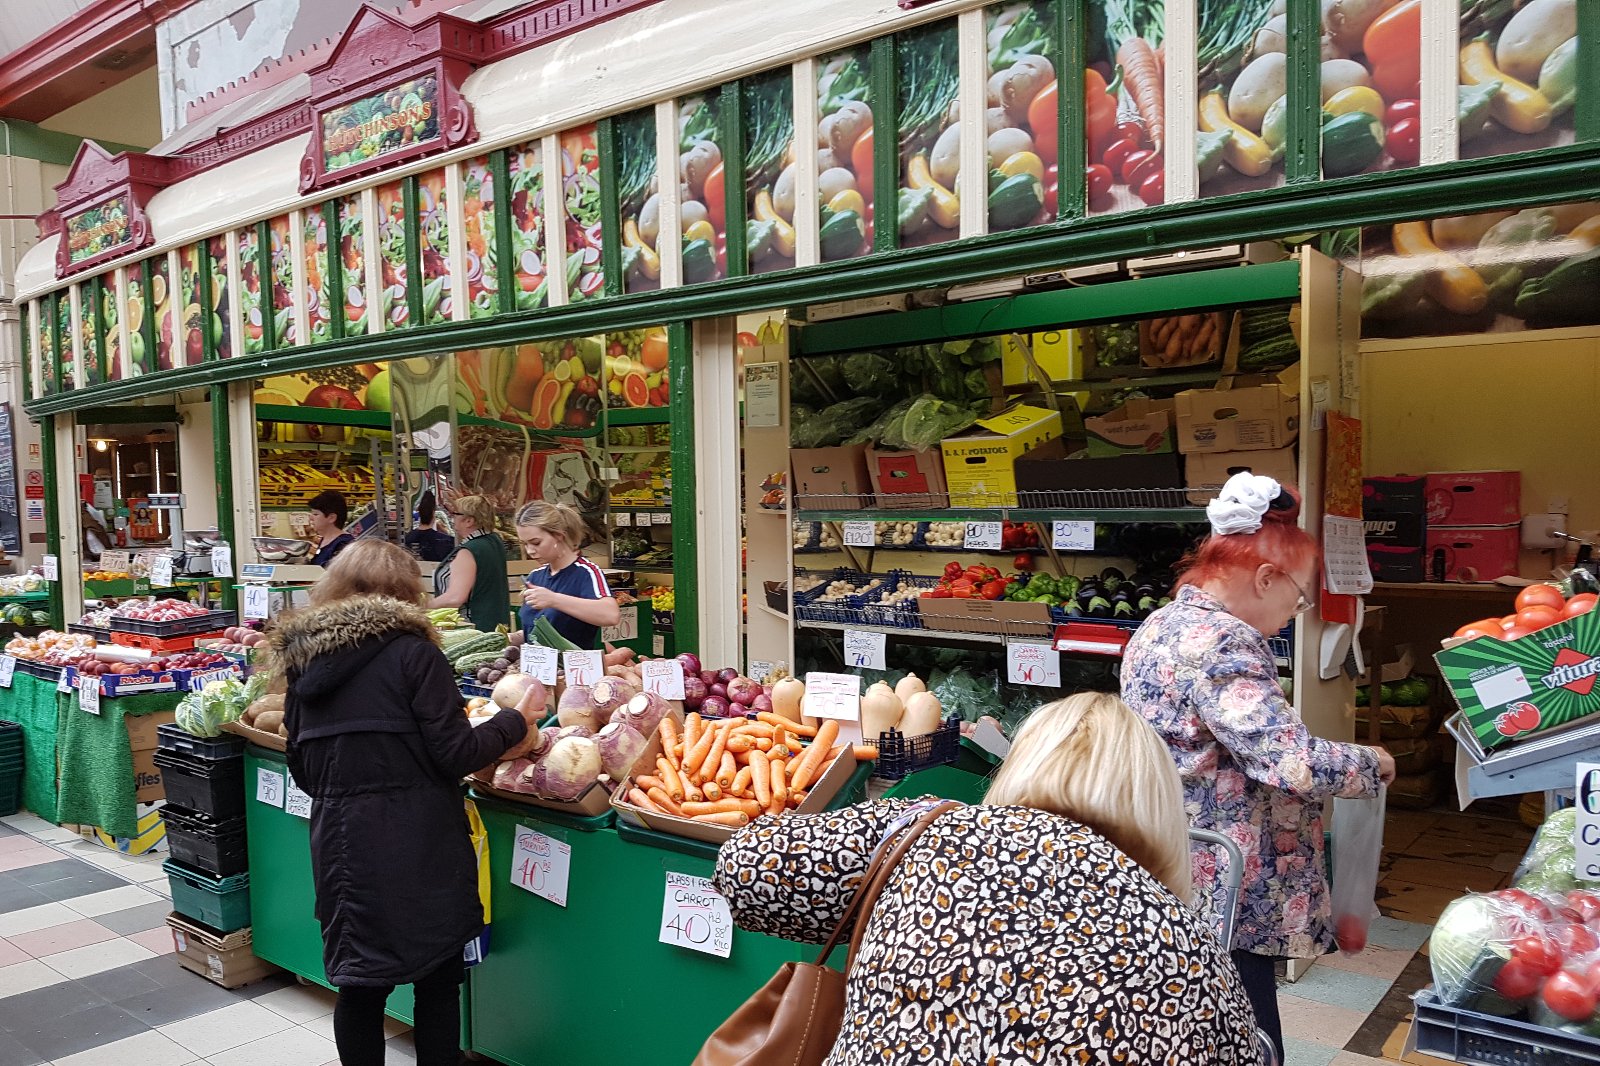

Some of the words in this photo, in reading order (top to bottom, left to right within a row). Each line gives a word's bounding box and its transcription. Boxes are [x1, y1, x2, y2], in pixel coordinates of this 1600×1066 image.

[968, 446, 1009, 455] POTATOES
[966, 523, 982, 538] 80
[1055, 522, 1073, 537] 80
[852, 652, 872, 667] 70
[1013, 662, 1046, 684] 50
[263, 785, 276, 801] 70
[517, 857, 546, 891] 40
[674, 889, 722, 908] CARROT
[665, 913, 711, 944] 40
[714, 938, 730, 950] KILO
